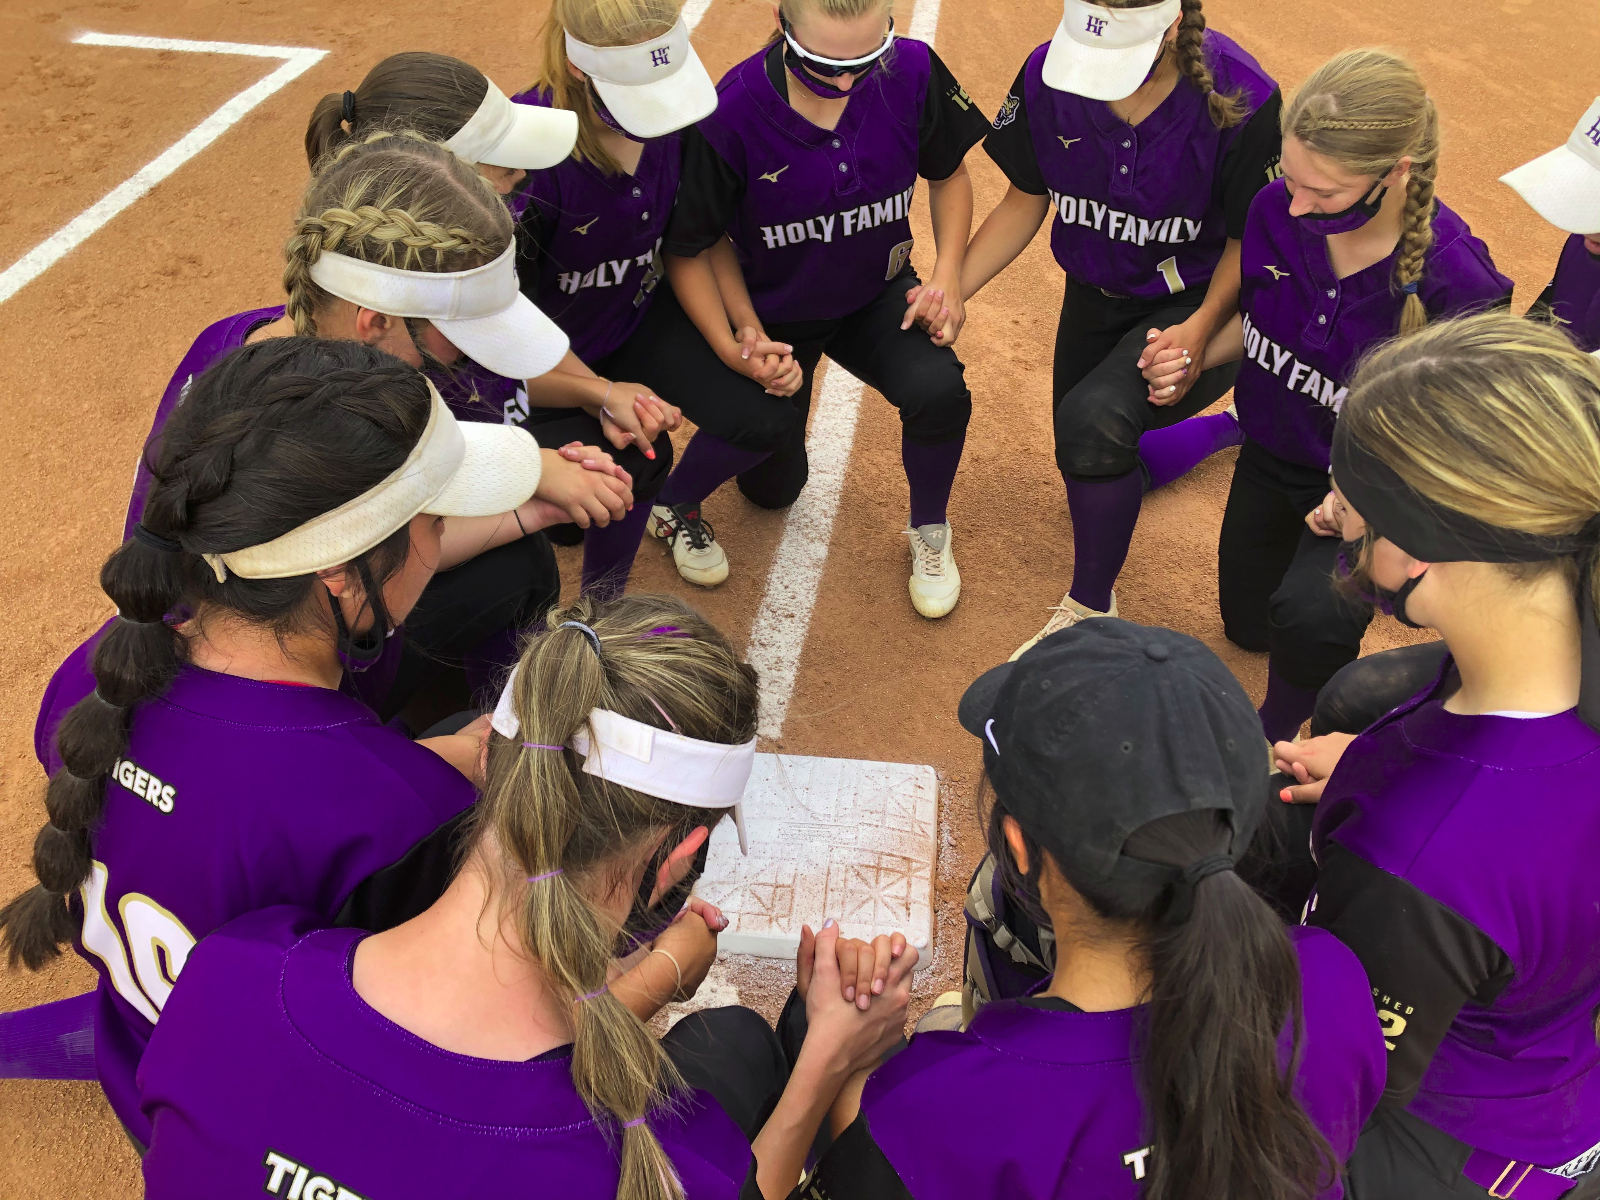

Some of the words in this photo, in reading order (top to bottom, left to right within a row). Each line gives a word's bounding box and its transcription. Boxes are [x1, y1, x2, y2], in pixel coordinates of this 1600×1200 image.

[760, 214, 836, 249] HOLY
[840, 184, 915, 236] FAMIL
[1107, 209, 1203, 247] FAMILY
[1156, 256, 1186, 294] 1
[1242, 311, 1293, 376] HOLY
[1286, 358, 1349, 418] FAM
[111, 757, 176, 813] IGERS
